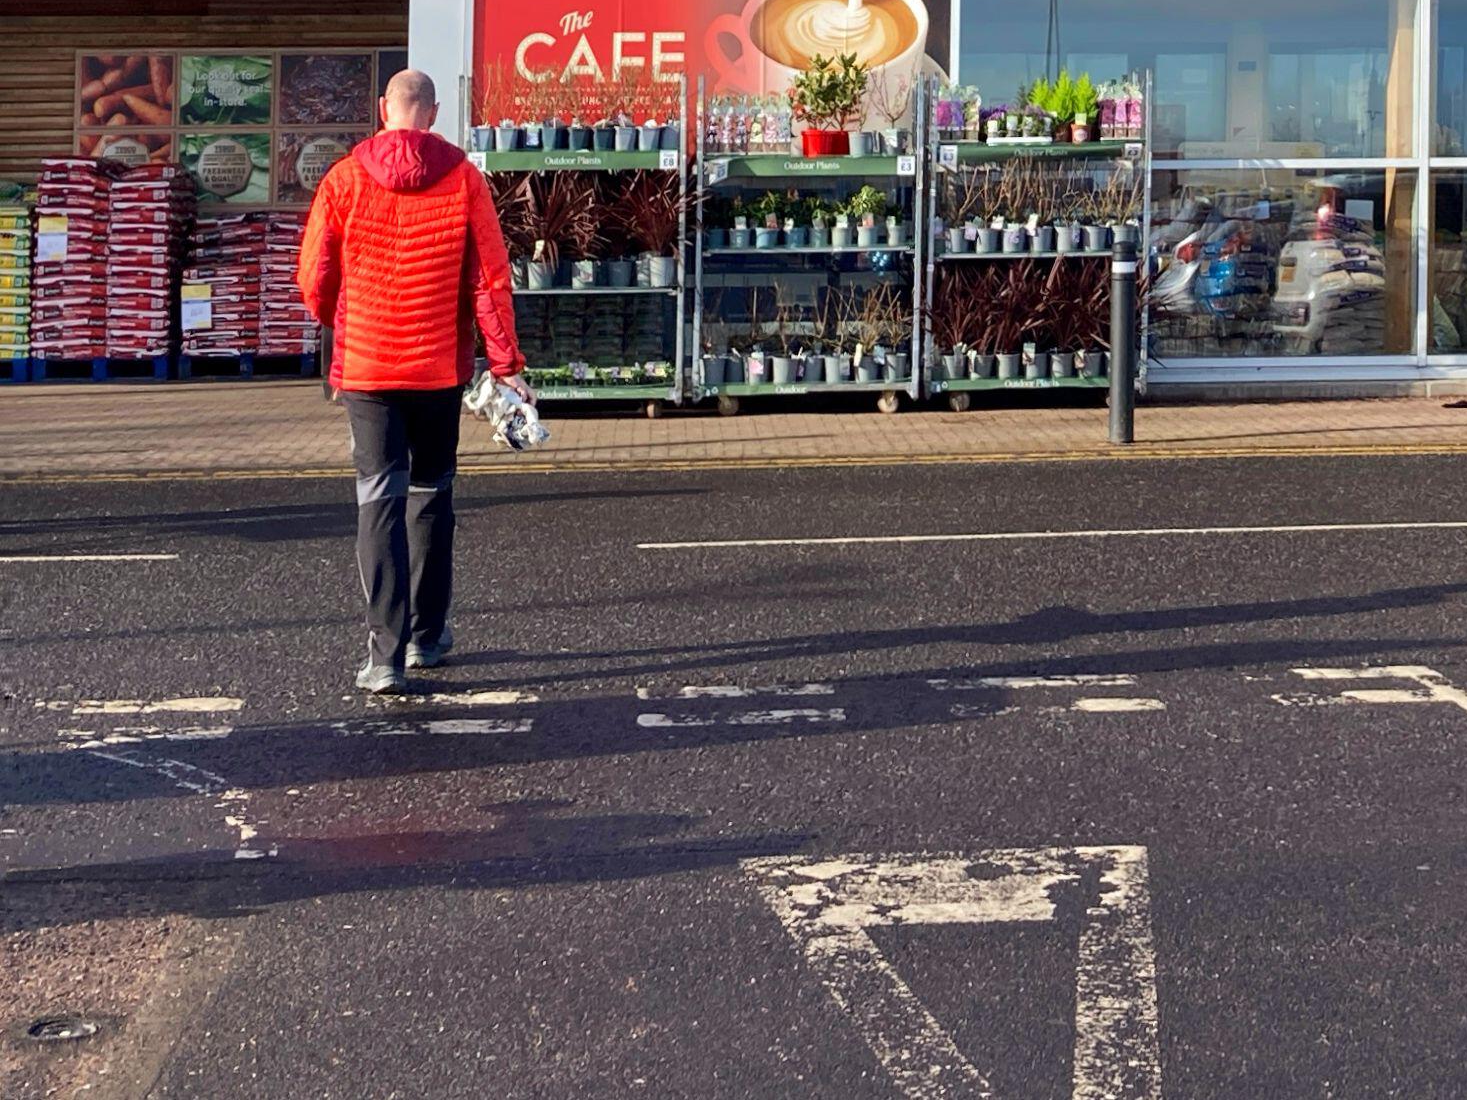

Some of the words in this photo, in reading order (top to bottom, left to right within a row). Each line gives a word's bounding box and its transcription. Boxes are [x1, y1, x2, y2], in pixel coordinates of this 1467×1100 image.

[559, 11, 594, 36] The
[514, 32, 686, 83] CAFE
[196, 71, 218, 80] Look
[223, 72, 240, 80] out
[241, 70, 256, 80] for
[544, 156, 574, 166] Outdoor
[576, 156, 602, 166] Plants
[663, 157, 675, 167] £8
[784, 161, 815, 170] Outdoor
[816, 160, 841, 170] Plants
[901, 162, 912, 171] £3
[1004, 379, 1034, 388] Outdoor
[775, 385, 807, 394] Outdoor
